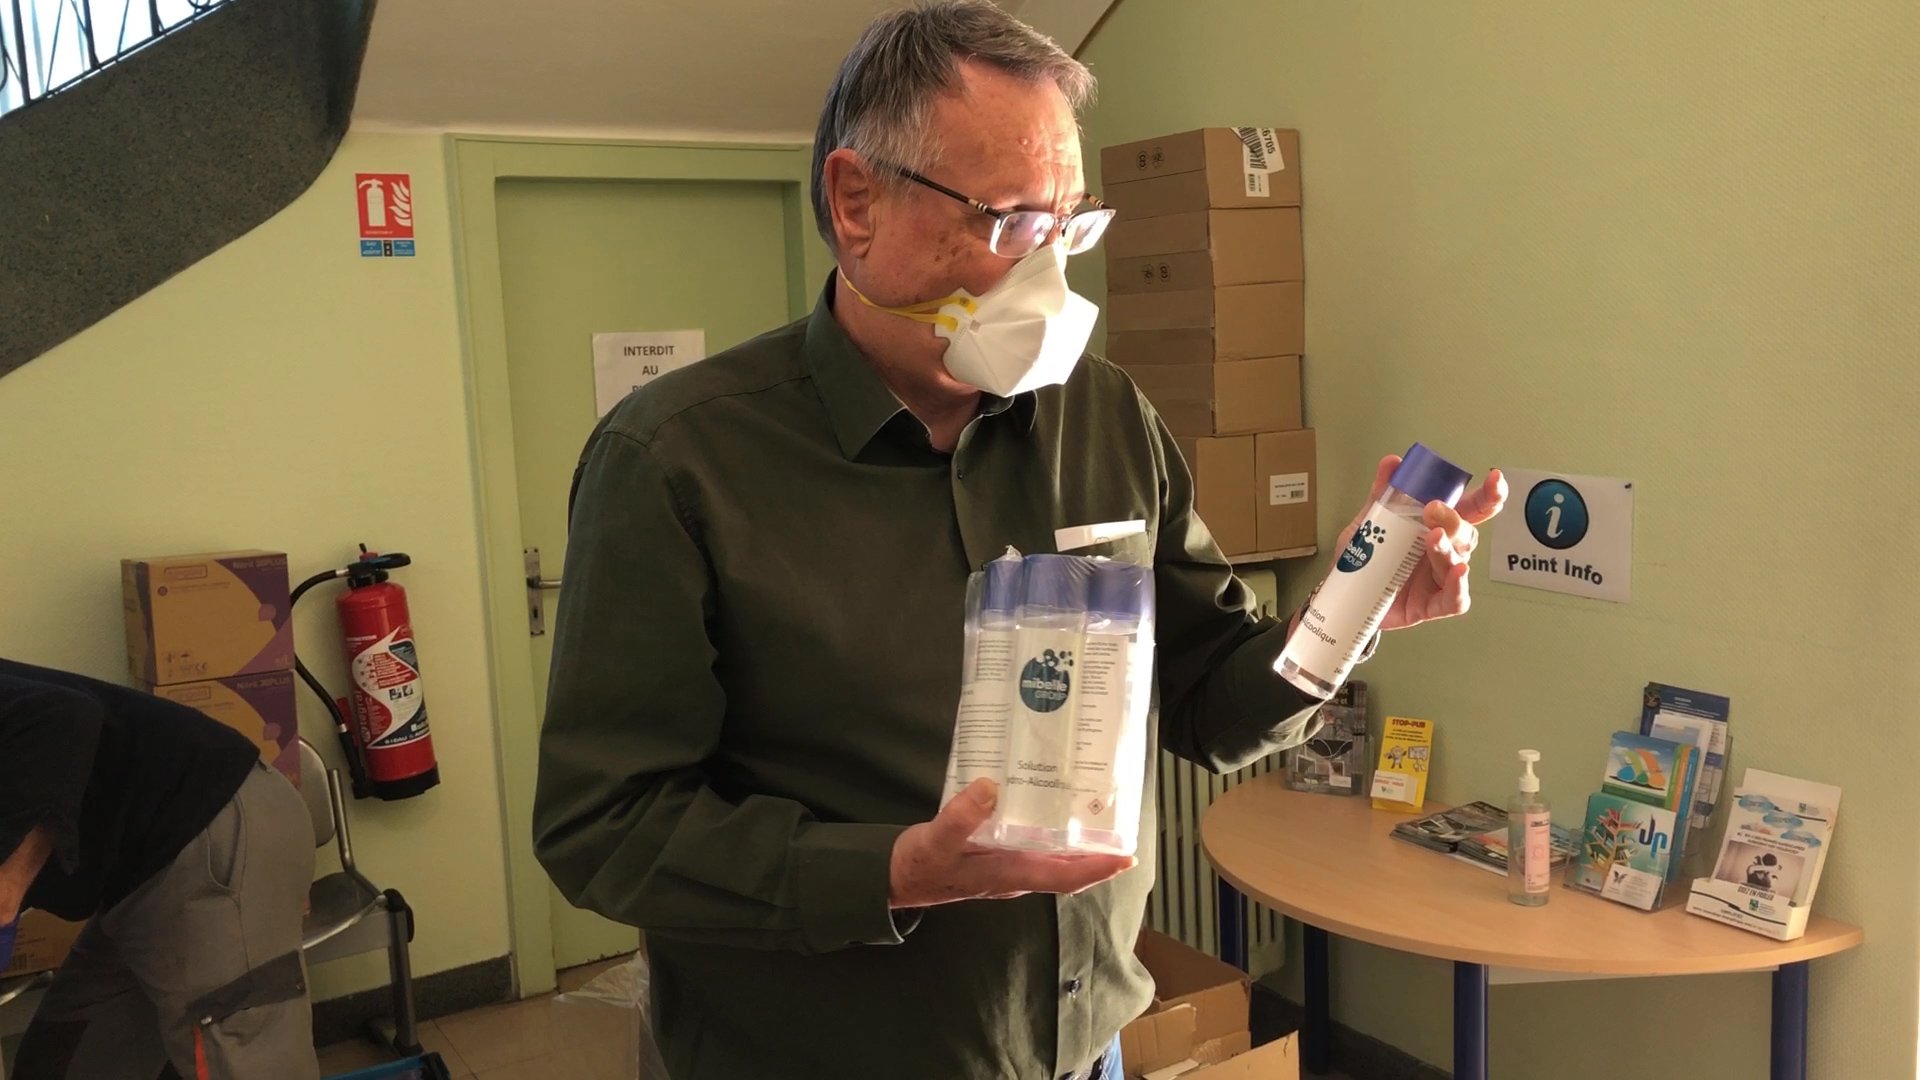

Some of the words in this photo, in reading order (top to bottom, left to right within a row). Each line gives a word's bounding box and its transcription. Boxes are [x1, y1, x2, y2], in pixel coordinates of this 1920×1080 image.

[623, 345, 675, 356] INTERDIT
[642, 365, 659, 376] AU
[1507, 554, 1557, 573] Point
[1564, 559, 1603, 585] Info
[1022, 677, 1068, 692] mibelle
[1392, 719, 1426, 729] STOP-PUB
[1017, 760, 1057, 773] Solution
